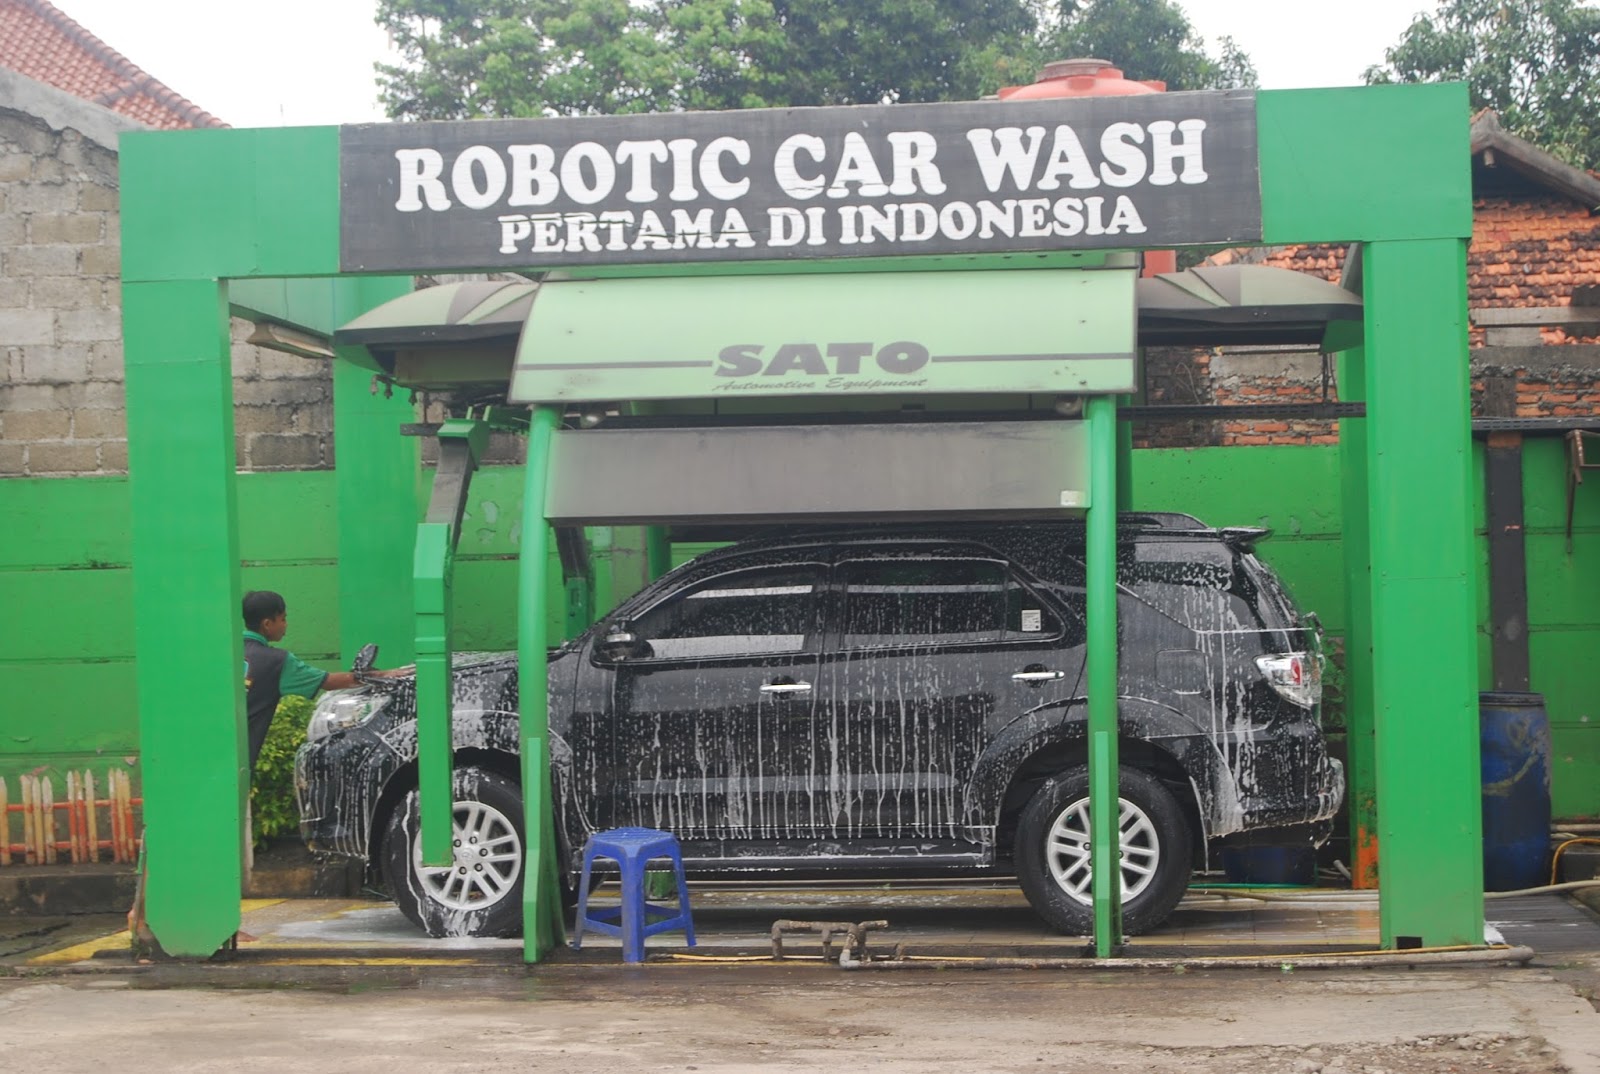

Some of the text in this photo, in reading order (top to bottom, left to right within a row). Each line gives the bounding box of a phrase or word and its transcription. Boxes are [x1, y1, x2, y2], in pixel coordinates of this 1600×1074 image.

[394, 119, 1208, 212] ROBOTIC CAR WASH
[498, 195, 1148, 254] PERTAMA DI INDONESIA
[714, 341, 929, 377] SATO
[712, 377, 928, 391] Automotive Equipment
